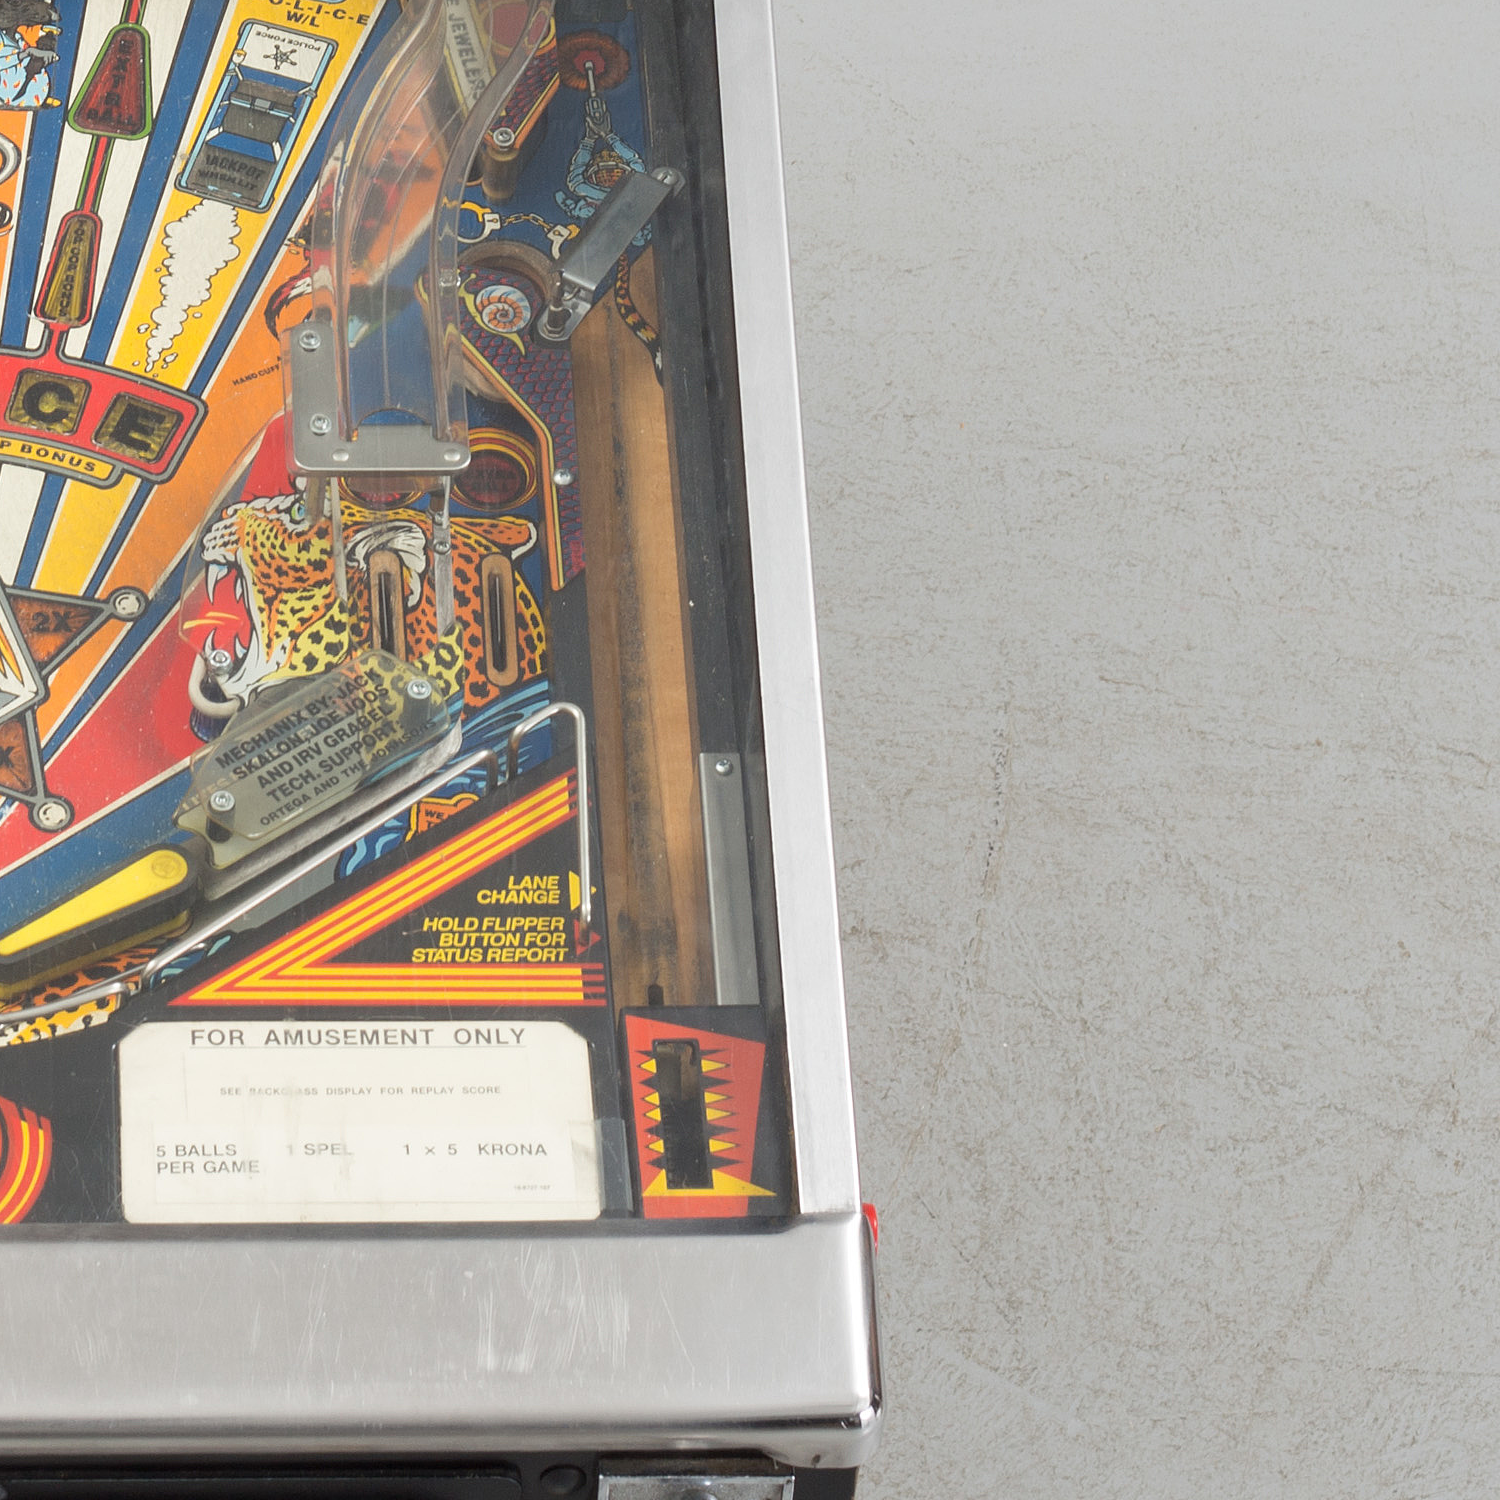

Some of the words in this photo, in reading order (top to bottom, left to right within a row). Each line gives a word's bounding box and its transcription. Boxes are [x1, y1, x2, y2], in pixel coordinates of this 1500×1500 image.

[286, 11, 321, 28] W/L
[19, 443, 97, 474] BONUS
[31, 611, 72, 633] 2X
[214, 710, 310, 770] MECHANIX
[331, 667, 382, 702] JACK
[232, 727, 314, 780] SKALON,
[308, 706, 341, 735] JOE
[339, 684, 390, 719] JOOS
[256, 759, 295, 789] AND
[292, 742, 324, 768] IRV
[323, 703, 397, 751] GRABEL
[313, 777, 341, 797] AND
[340, 760, 370, 781] THE
[266, 770, 321, 805] TECH.
[507, 875, 561, 890] LANE
[476, 890, 561, 905] CHANGE
[422, 916, 480, 932] HOLD
[481, 916, 566, 932] FLIPPER
[438, 932, 521, 948] BUTTON
[523, 932, 567, 948] FOR
[410, 947, 484, 964] STATUS
[486, 947, 569, 963] REPORT
[190, 1028, 245, 1046] FOR
[263, 1028, 434, 1046] AMUSEMENT
[453, 1027, 526, 1045] ONLY
[325, 1086, 372, 1096] DISPLAY
[380, 1086, 404, 1096] FOR
[411, 1086, 455, 1096] REPLAY
[461, 1085, 501, 1095] SCORE
[156, 1145, 166, 1157] 5
[175, 1143, 238, 1157] BALLS
[477, 1143, 548, 1157] KRONA
[156, 1161, 195, 1175] PER
[203, 1160, 261, 1174] GAME
